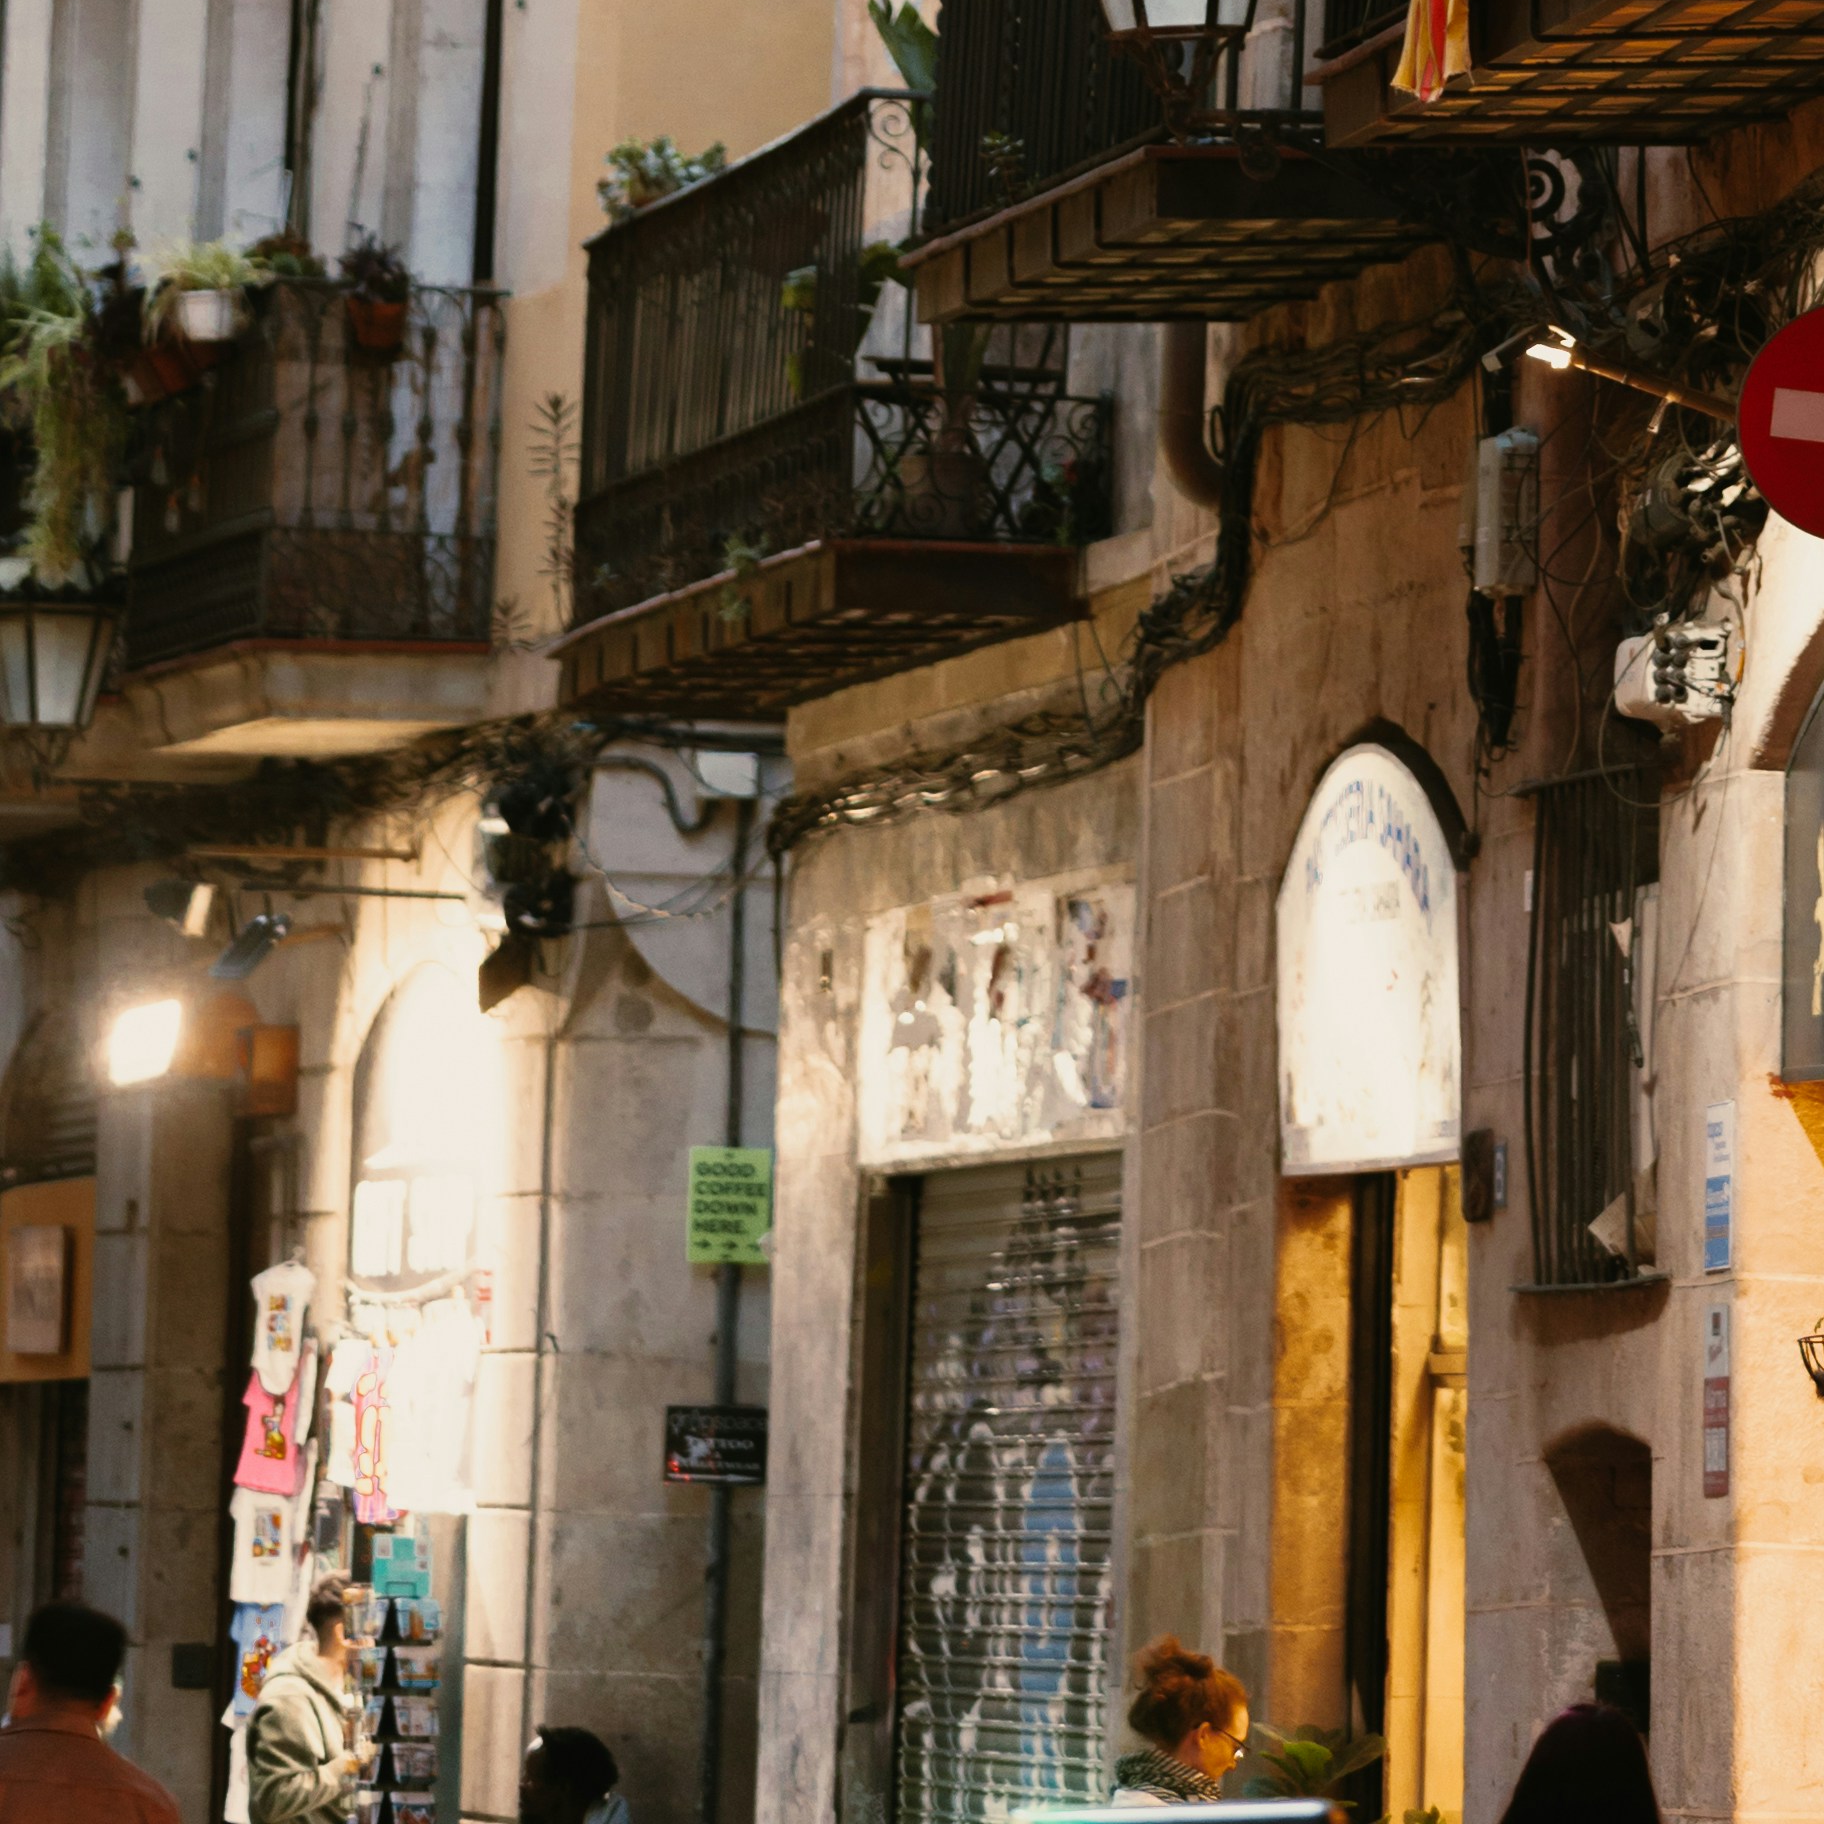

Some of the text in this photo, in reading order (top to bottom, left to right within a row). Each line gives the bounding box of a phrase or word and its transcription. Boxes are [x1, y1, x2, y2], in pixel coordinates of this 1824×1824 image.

[696, 1161, 756, 1177] GOOD
[695, 1181, 768, 1197] COFFEE
[695, 1199, 757, 1216] DOWN
